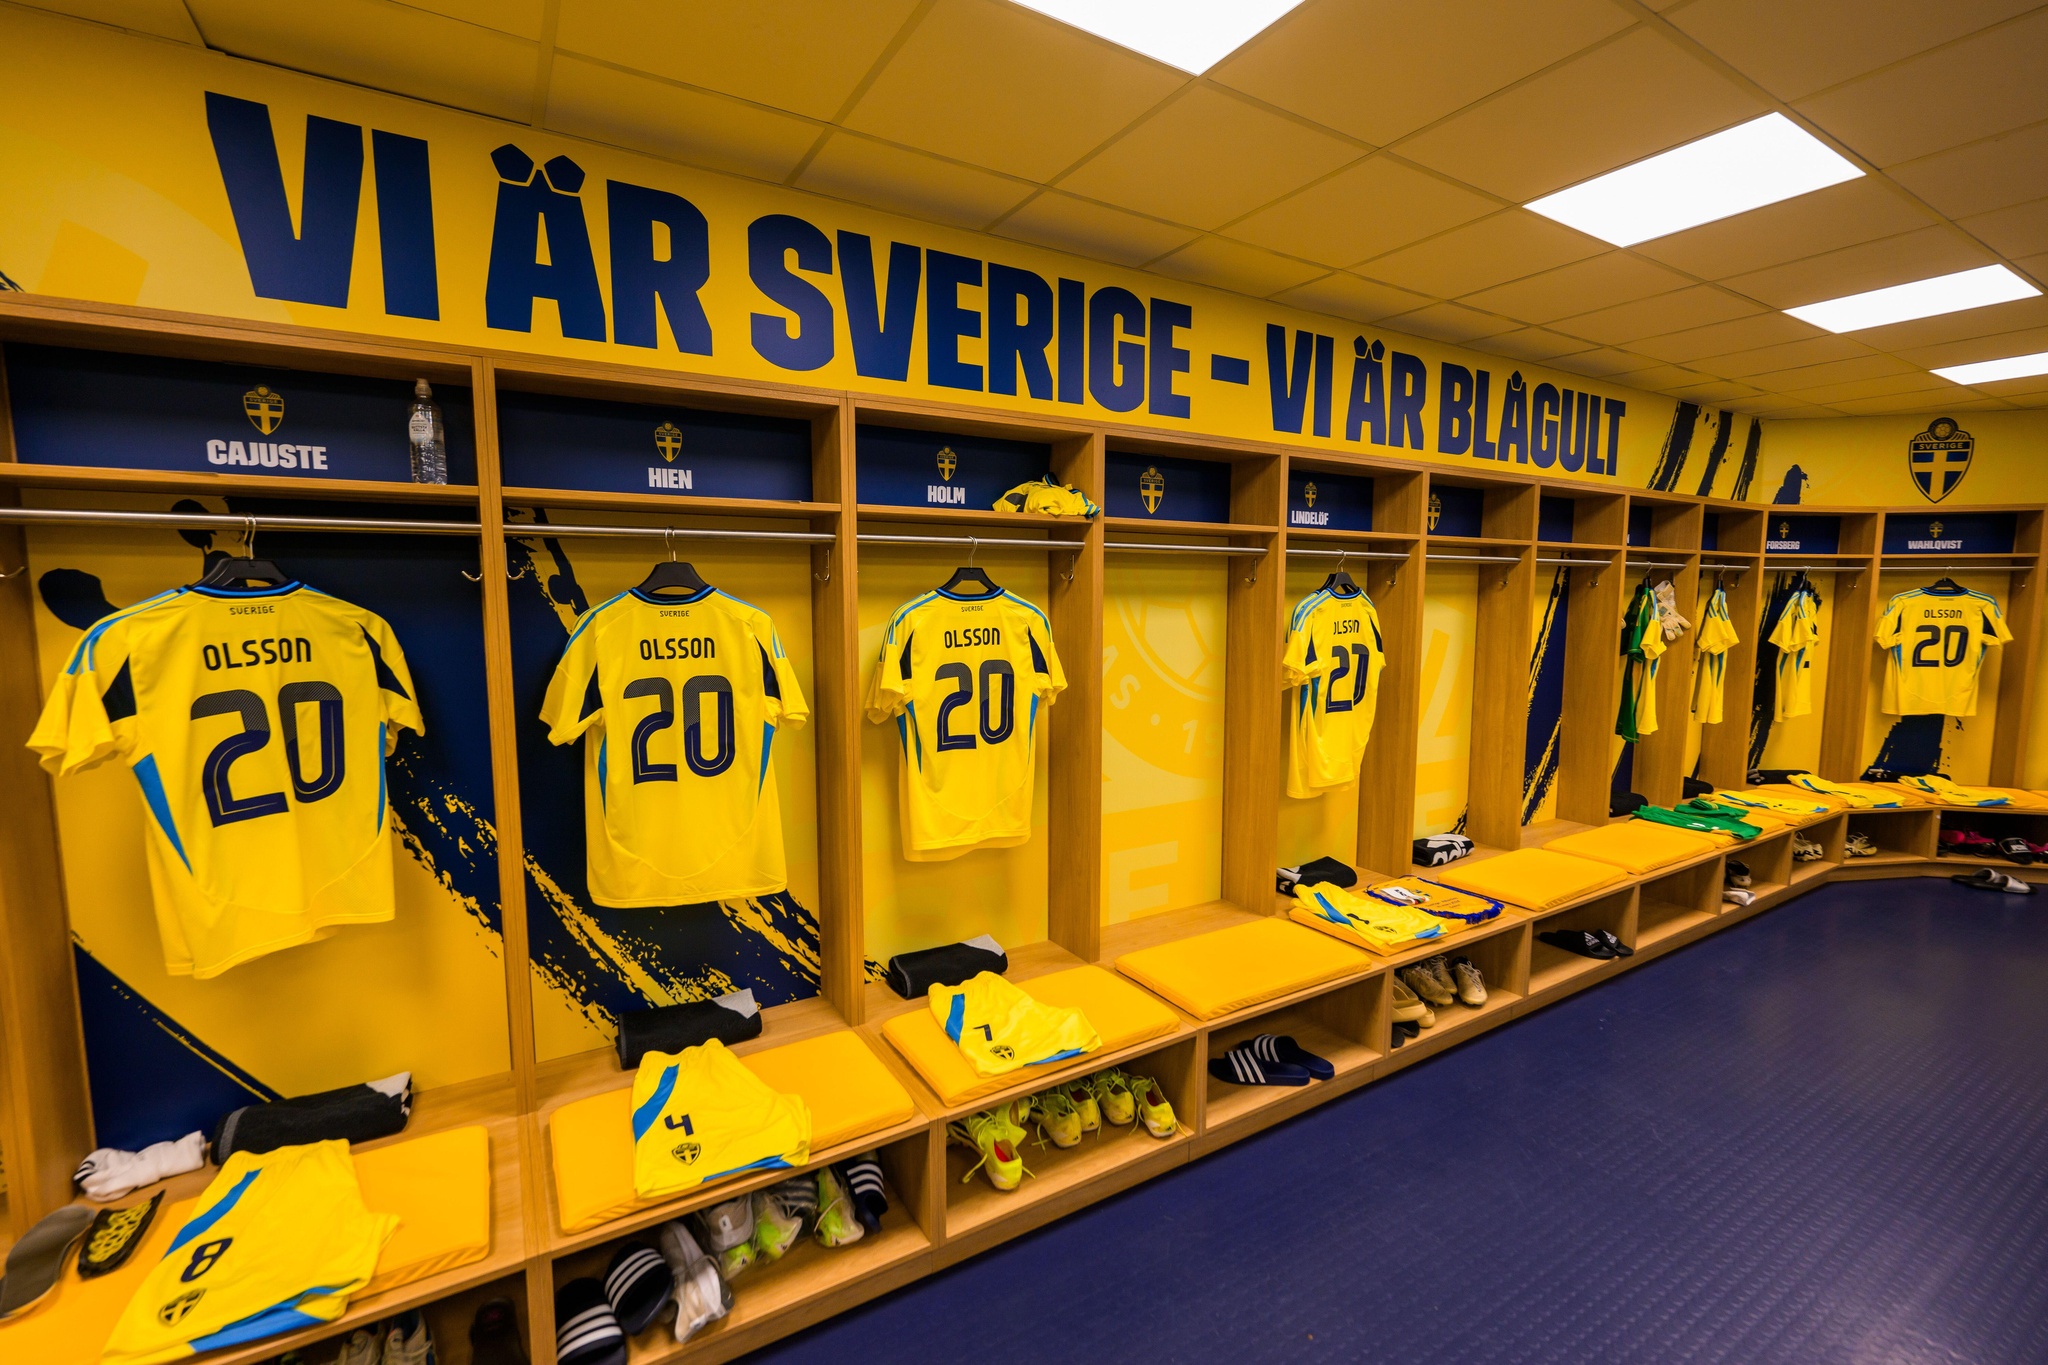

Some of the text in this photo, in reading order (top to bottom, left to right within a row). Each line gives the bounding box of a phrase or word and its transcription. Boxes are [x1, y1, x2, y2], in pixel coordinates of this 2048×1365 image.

[205, 91, 440, 321] VI
[486, 144, 713, 356] ÄR
[748, 214, 1192, 419] SVERIGE
[1266, 323, 1334, 438] VI
[1346, 335, 1427, 450] ÄR
[1438, 362, 1626, 477] BLÅGULT
[206, 439, 328, 470] CAJUSTE
[1919, 442, 1964, 450] SVERIGE
[648, 467, 692, 489] HIEN
[927, 485, 965, 504] HOLM
[1291, 510, 1329, 525] LINDELÖF
[1766, 540, 1800, 550] FORSBERG
[1908, 540, 1962, 550] WAHLQVIST
[229, 605, 275, 615] SVERIGE
[1924, 609, 1962, 619] OLSSON
[639, 637, 715, 660] OLSSON
[944, 627, 1000, 649] OLSSON
[1912, 625, 1969, 667] 20
[203, 637, 311, 671] OLSSON
[935, 659, 1014, 752] 20
[623, 675, 736, 785] 20
[190, 681, 345, 828] 20
[973, 1023, 993, 1041] 7
[664, 1113, 694, 1136] 4
[180, 1237, 233, 1283] 8
